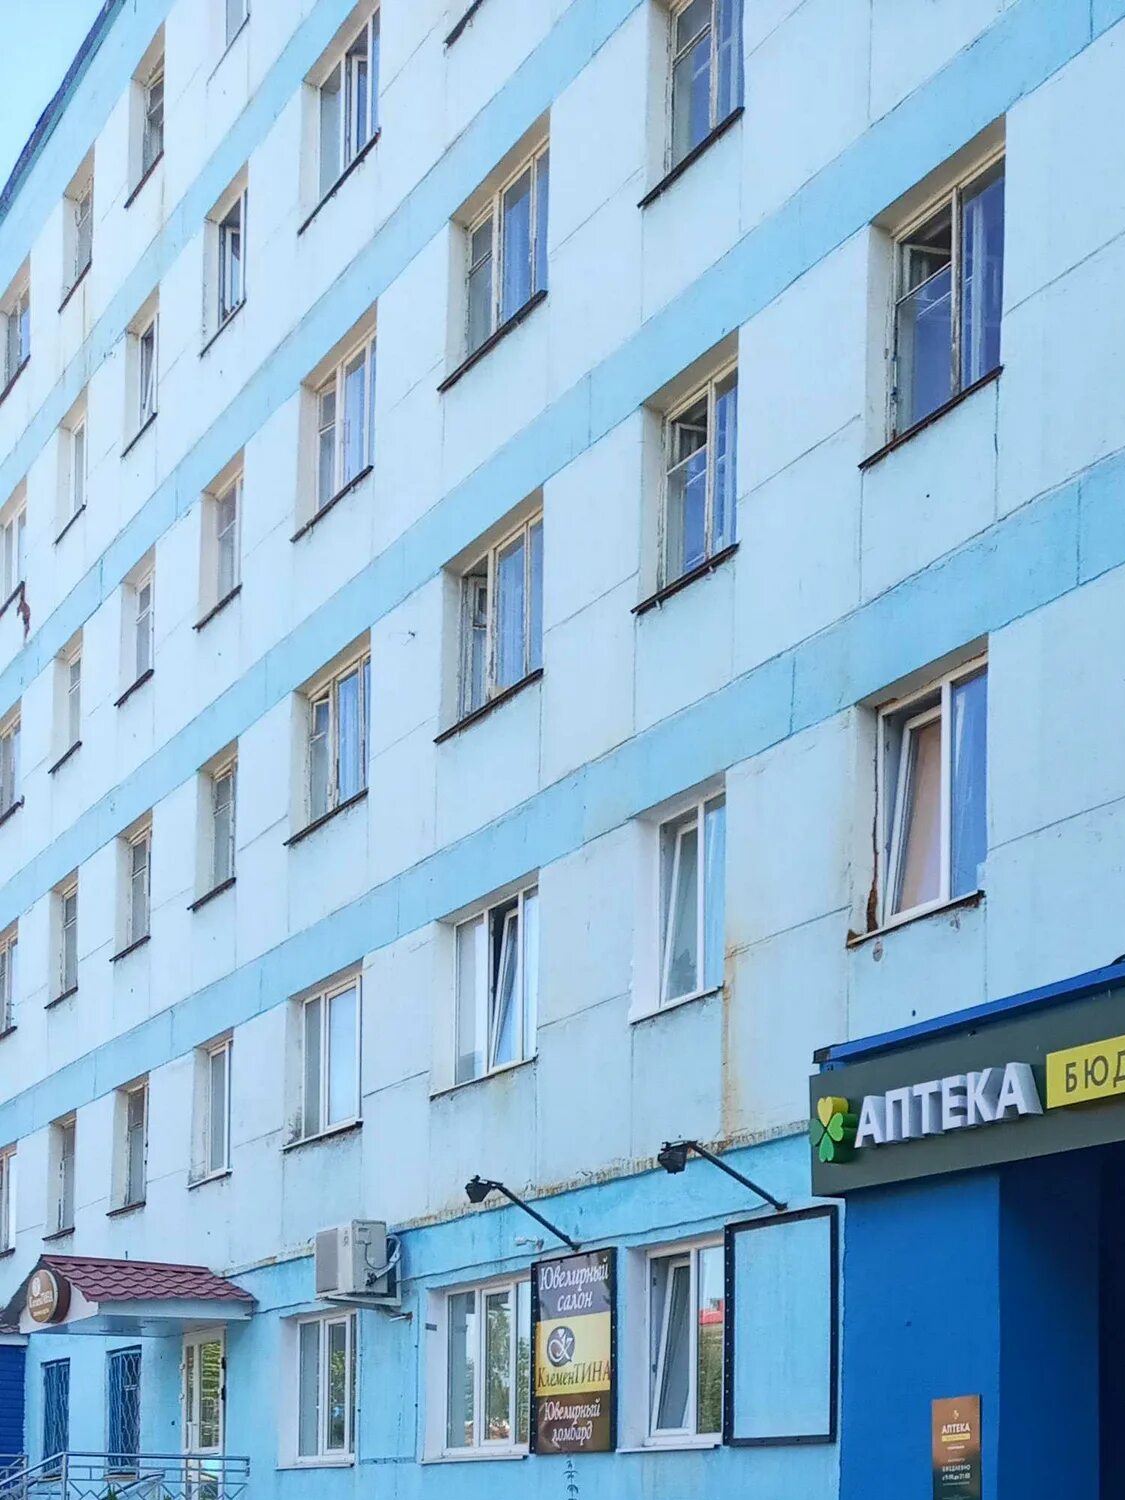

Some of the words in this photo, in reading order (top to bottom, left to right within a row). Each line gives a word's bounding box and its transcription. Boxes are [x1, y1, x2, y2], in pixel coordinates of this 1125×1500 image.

[853, 1061, 1044, 1149] АПТЕКА
[540, 1256, 609, 1291] Ювелирный
[557, 1291, 592, 1312] салон
[538, 1359, 610, 1388] КлеменТИНА
[544, 1398, 601, 1424] Ювелирный
[552, 1424, 593, 1446] ломбард
[942, 1423, 970, 1434] АПТЕКА
